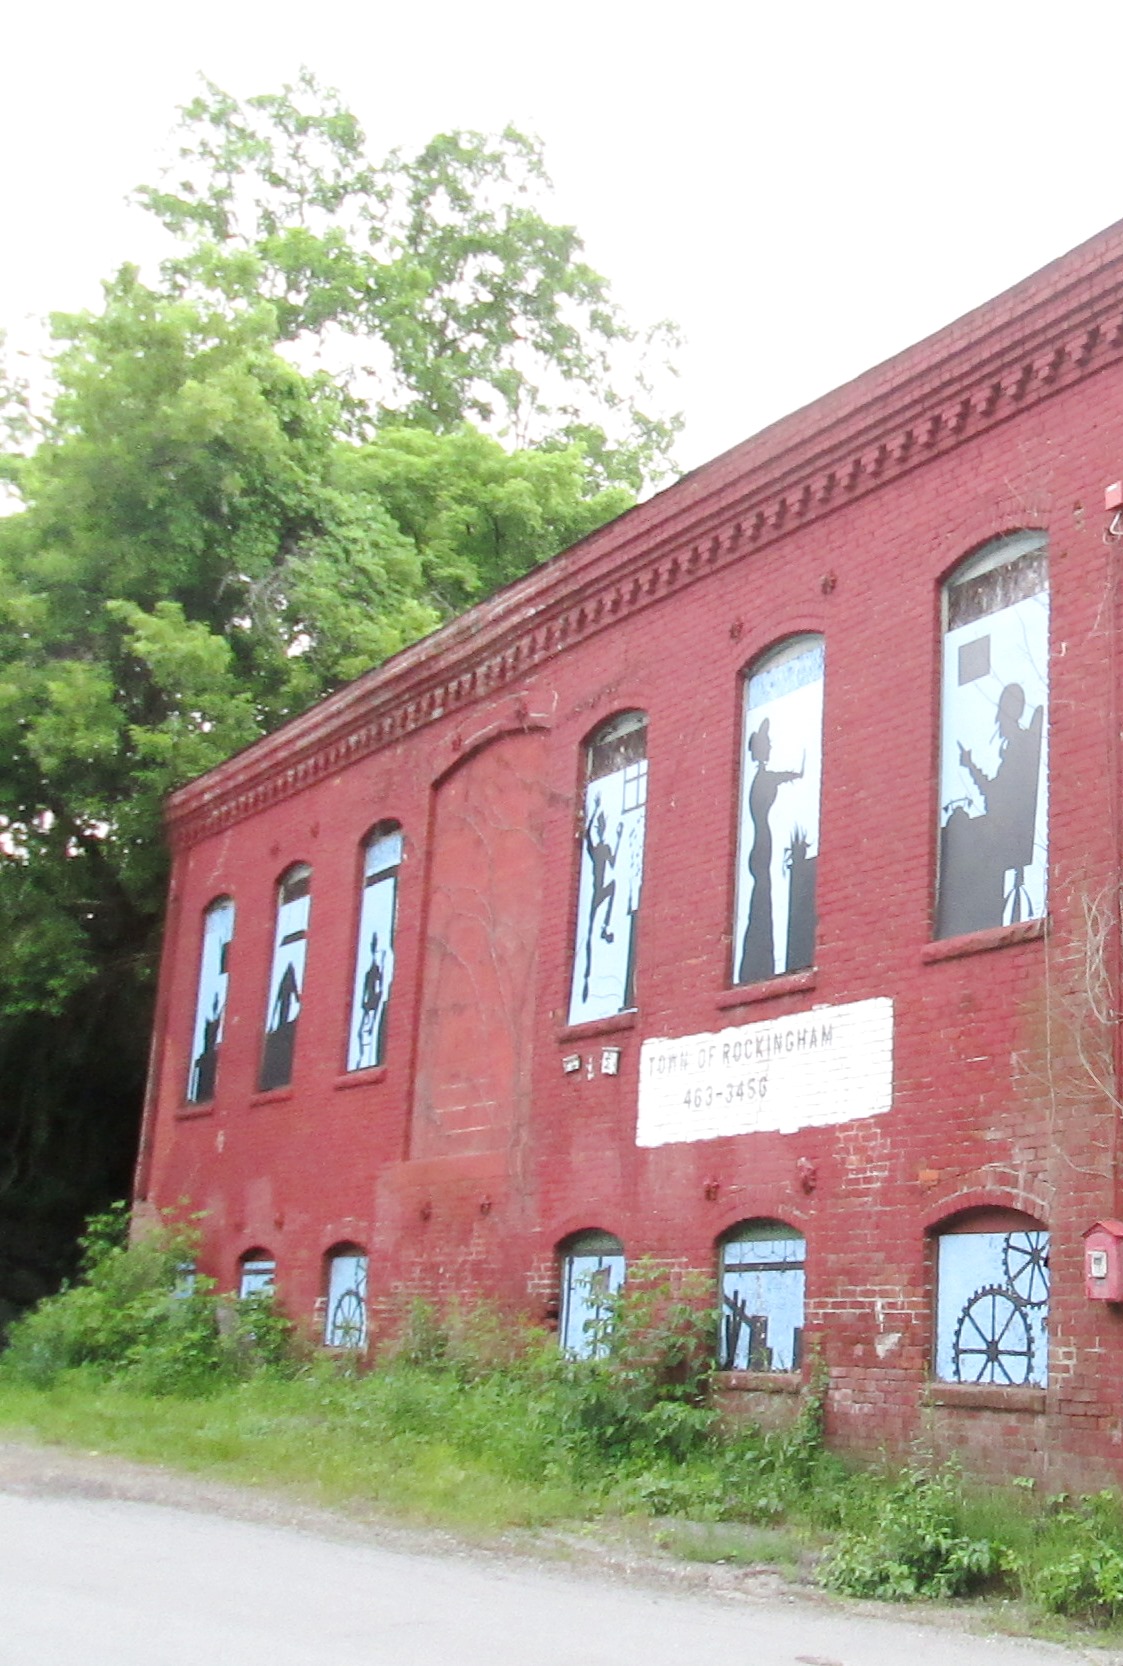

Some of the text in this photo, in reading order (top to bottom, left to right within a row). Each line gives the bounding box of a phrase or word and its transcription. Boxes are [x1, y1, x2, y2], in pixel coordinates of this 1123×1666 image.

[648, 1023, 833, 1076] TOWN OF ROCKINGHAM
[683, 1077, 768, 1109] 463-3456
